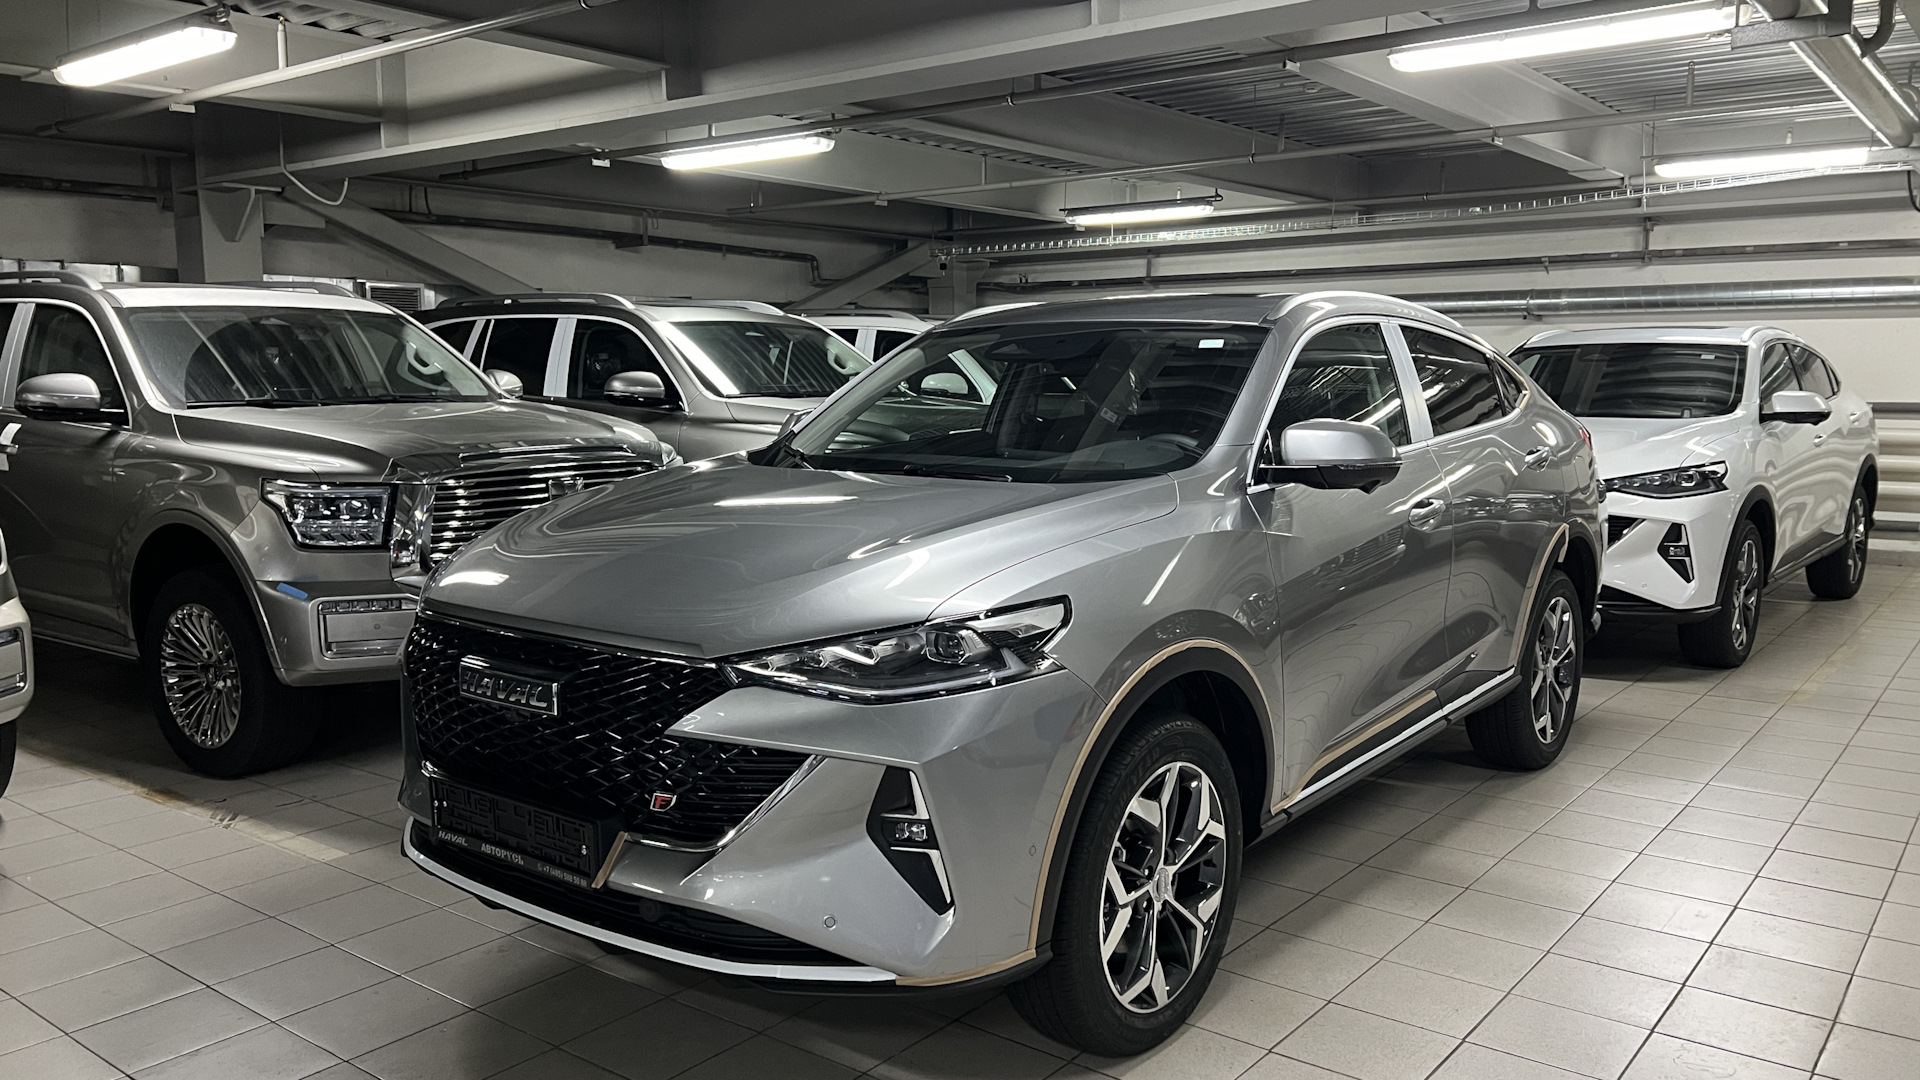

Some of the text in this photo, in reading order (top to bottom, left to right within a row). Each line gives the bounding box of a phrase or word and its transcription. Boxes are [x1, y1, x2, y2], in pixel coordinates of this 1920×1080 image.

[462, 672, 547, 707] HAVAL
[438, 830, 468, 846] HAVAL
[481, 843, 524, 865] АВТОРУСЬ
